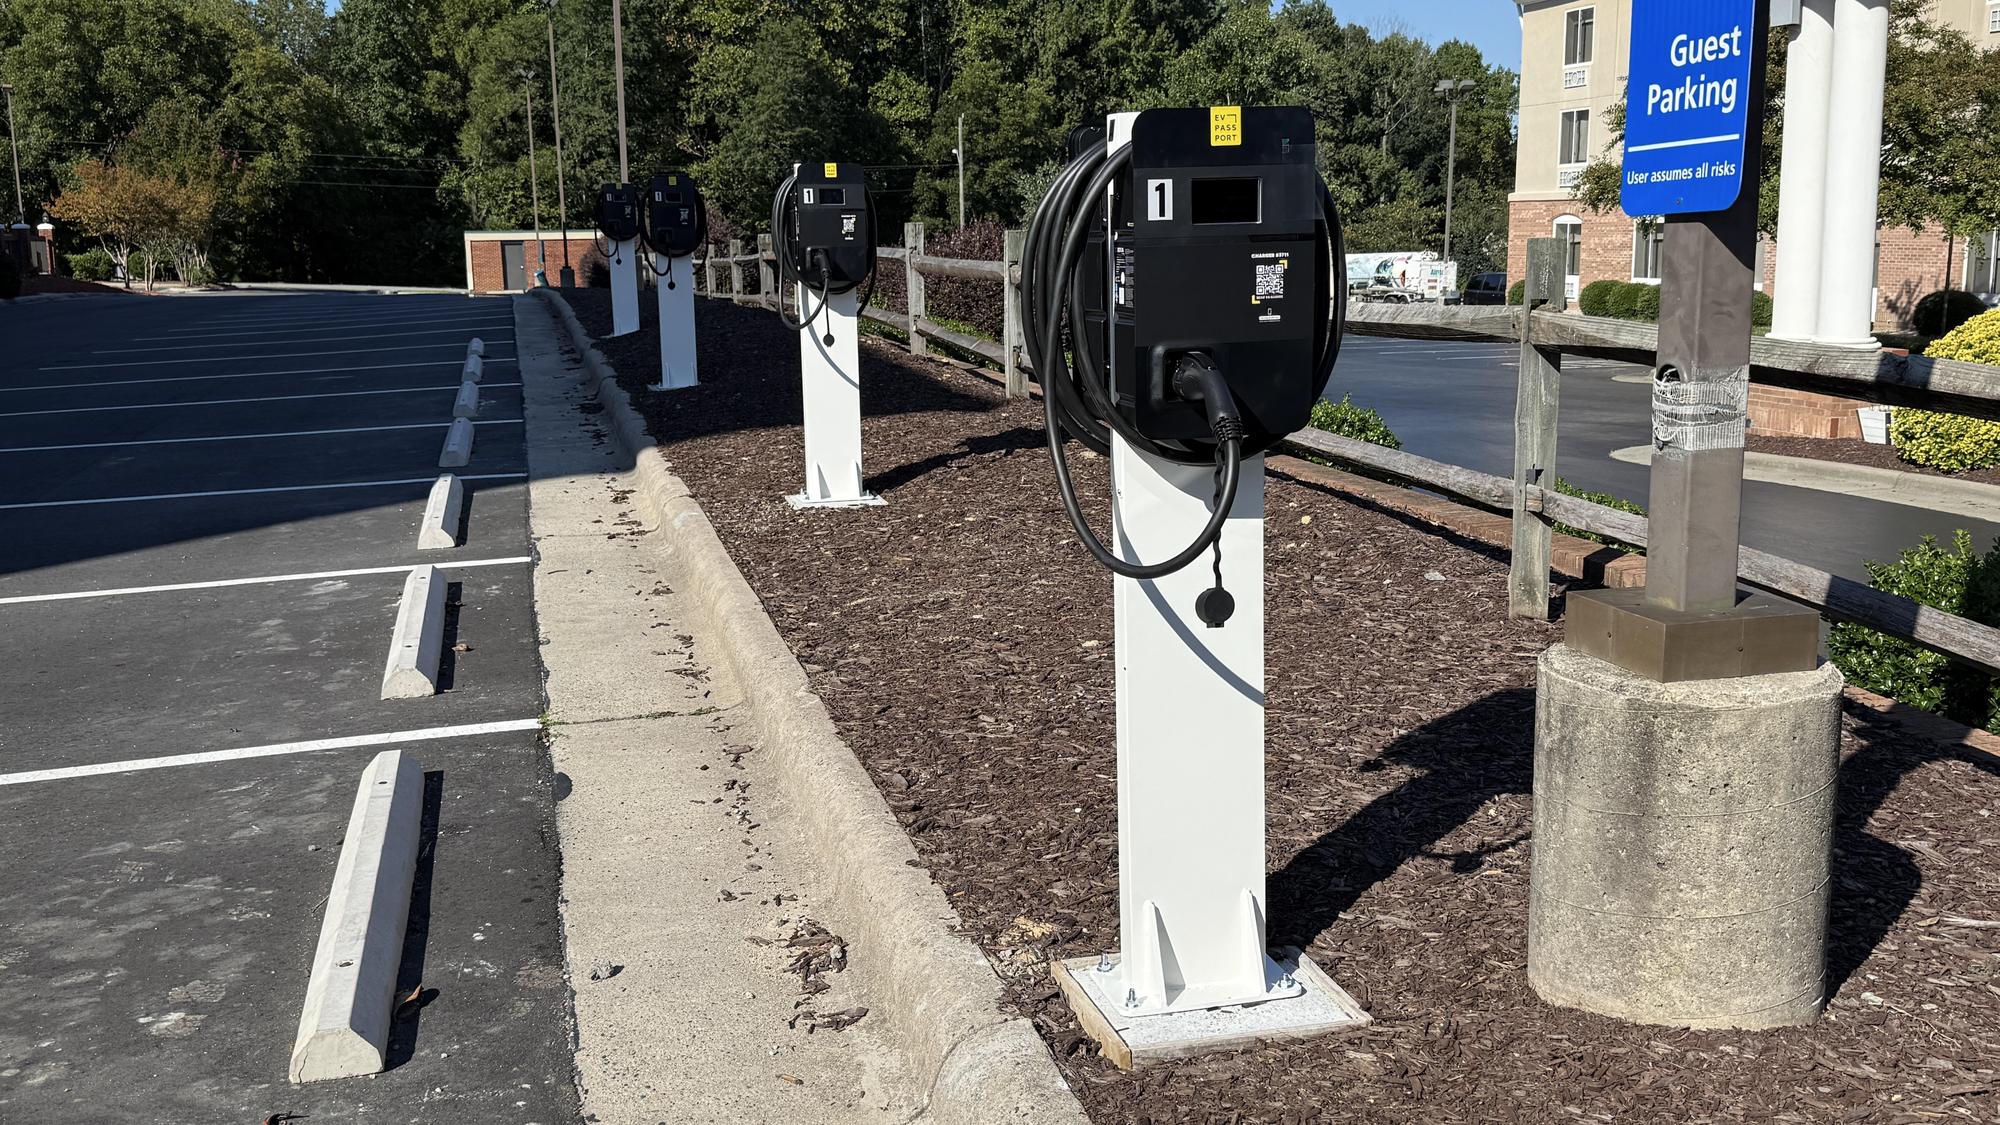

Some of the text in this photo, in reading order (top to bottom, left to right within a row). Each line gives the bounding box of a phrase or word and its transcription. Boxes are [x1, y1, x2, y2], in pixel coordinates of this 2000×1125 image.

[1670, 25, 1742, 67] Guest
[1647, 74, 1737, 115] Parking
[1215, 134, 1237, 142] PORT
[1627, 160, 1736, 184] User assumes all risks
[806, 190, 811, 203] 1
[1155, 182, 1165, 217] 1
